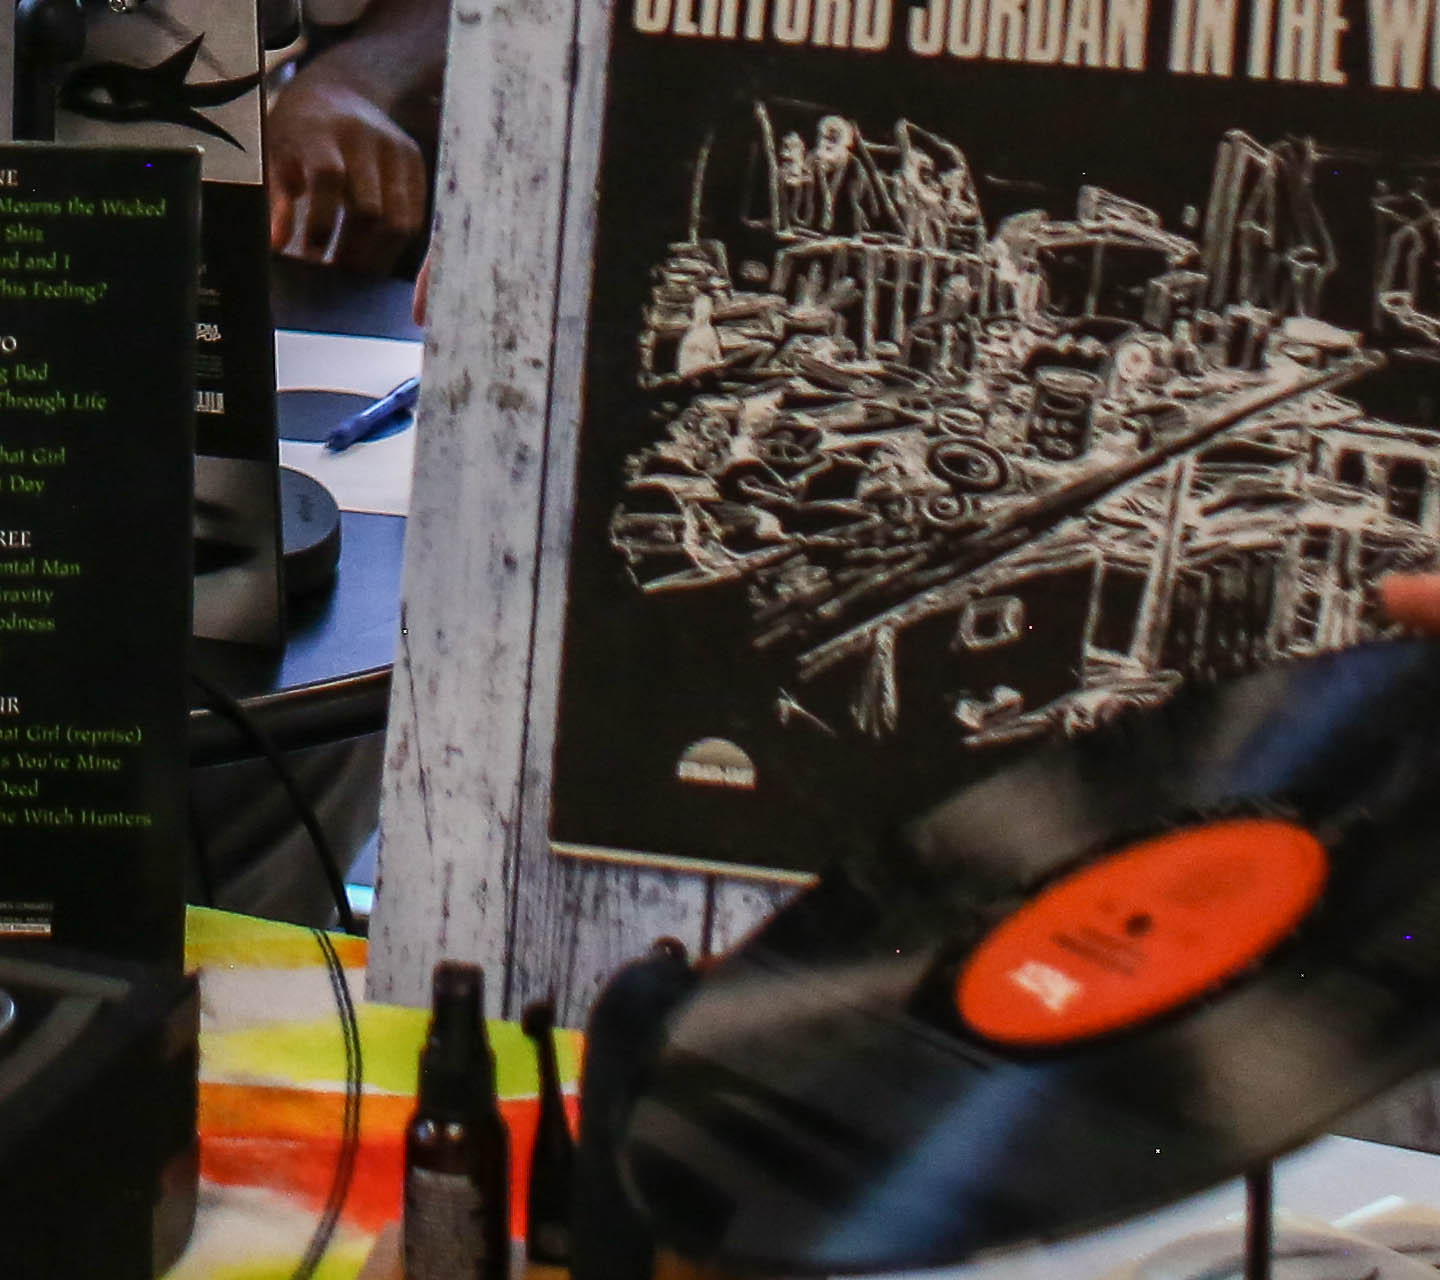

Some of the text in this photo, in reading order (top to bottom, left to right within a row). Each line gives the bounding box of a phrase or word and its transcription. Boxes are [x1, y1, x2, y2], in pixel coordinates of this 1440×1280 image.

[68, 196, 95, 215] the
[102, 198, 166, 217] Wicked
[24, 251, 57, 270] and
[33, 280, 108, 304] Feeling?
[15, 362, 49, 381] Bad
[73, 393, 107, 411] Life
[31, 447, 66, 465] Girl
[9, 475, 45, 492] Day
[42, 559, 81, 576] Man
[26, 724, 60, 742] Girl
[66, 726, 143, 745] (reprise)
[16, 753, 70, 769] You're
[77, 754, 121, 771] Mine
[23, 807, 74, 825] Witch
[81, 810, 153, 827] Hunters
